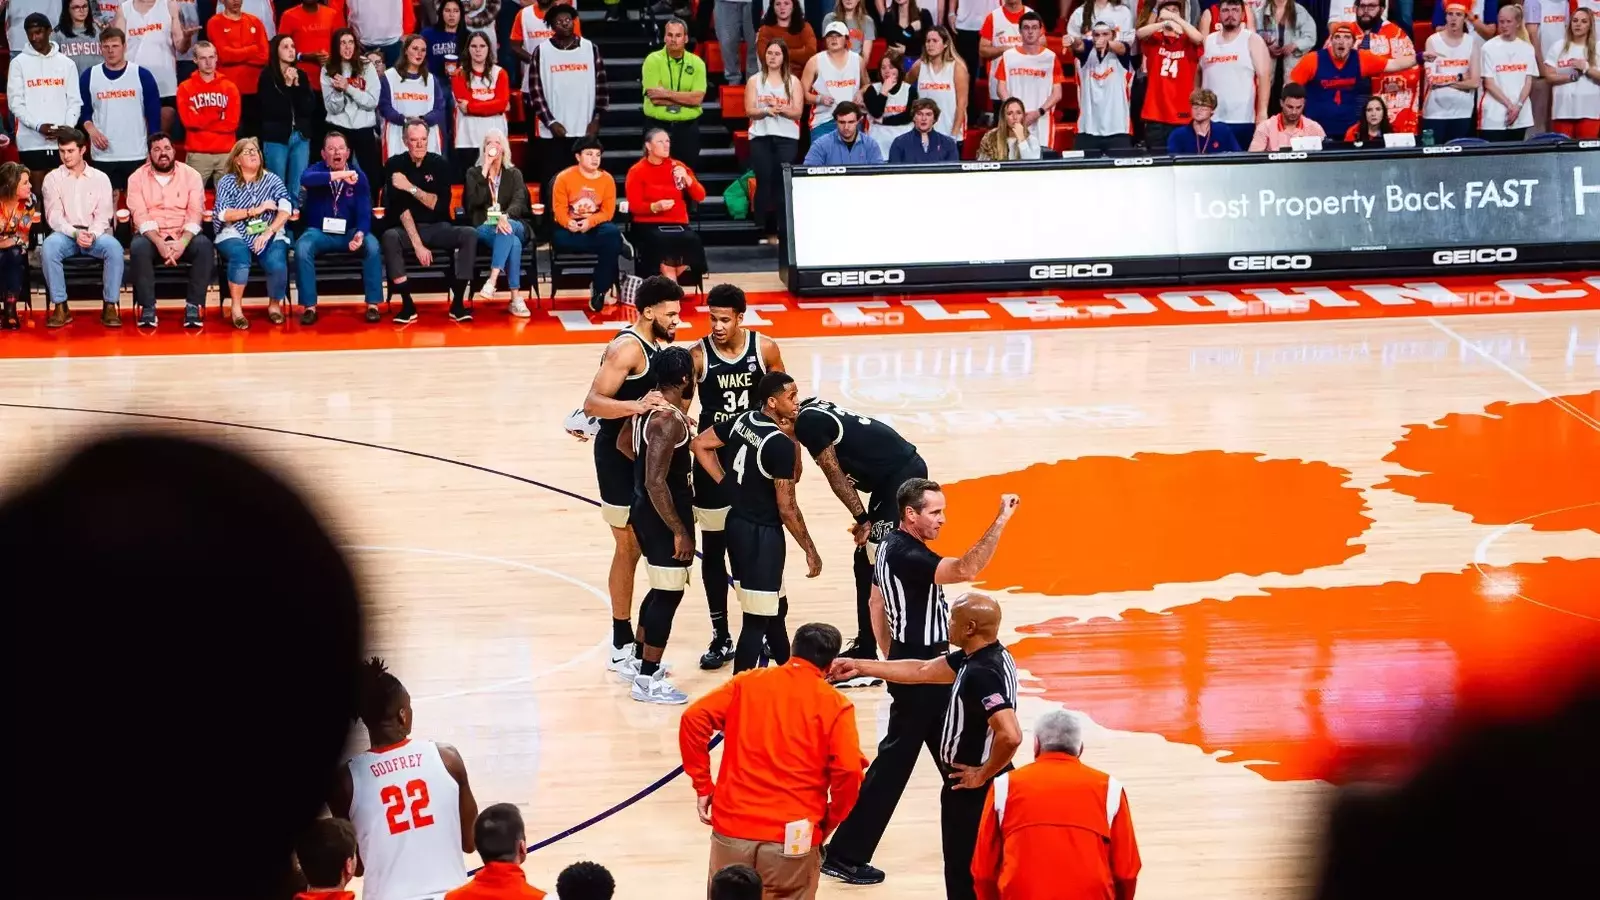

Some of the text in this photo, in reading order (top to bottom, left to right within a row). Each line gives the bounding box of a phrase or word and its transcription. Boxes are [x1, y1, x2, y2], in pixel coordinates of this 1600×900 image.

[1160, 58, 1178, 78] 24
[96, 88, 136, 100] CLEMSON
[1268, 151, 1308, 161] GEICO
[1423, 145, 1462, 154] GEICO
[961, 162, 1000, 171] GEICO
[1114, 157, 1153, 166] GEICO
[807, 166, 846, 175] GEICO
[1194, 179, 1540, 220] Lost Property Back FAST
[1228, 255, 1312, 272] GEICO
[1433, 247, 1518, 265] GEICO
[821, 269, 906, 287] GEICO
[1029, 263, 1114, 280] GEICO
[717, 372, 753, 389] WAKE
[723, 389, 750, 413] 34
[732, 443, 748, 486] 4
[369, 753, 423, 778] GODFREY
[380, 778, 435, 836] 22
